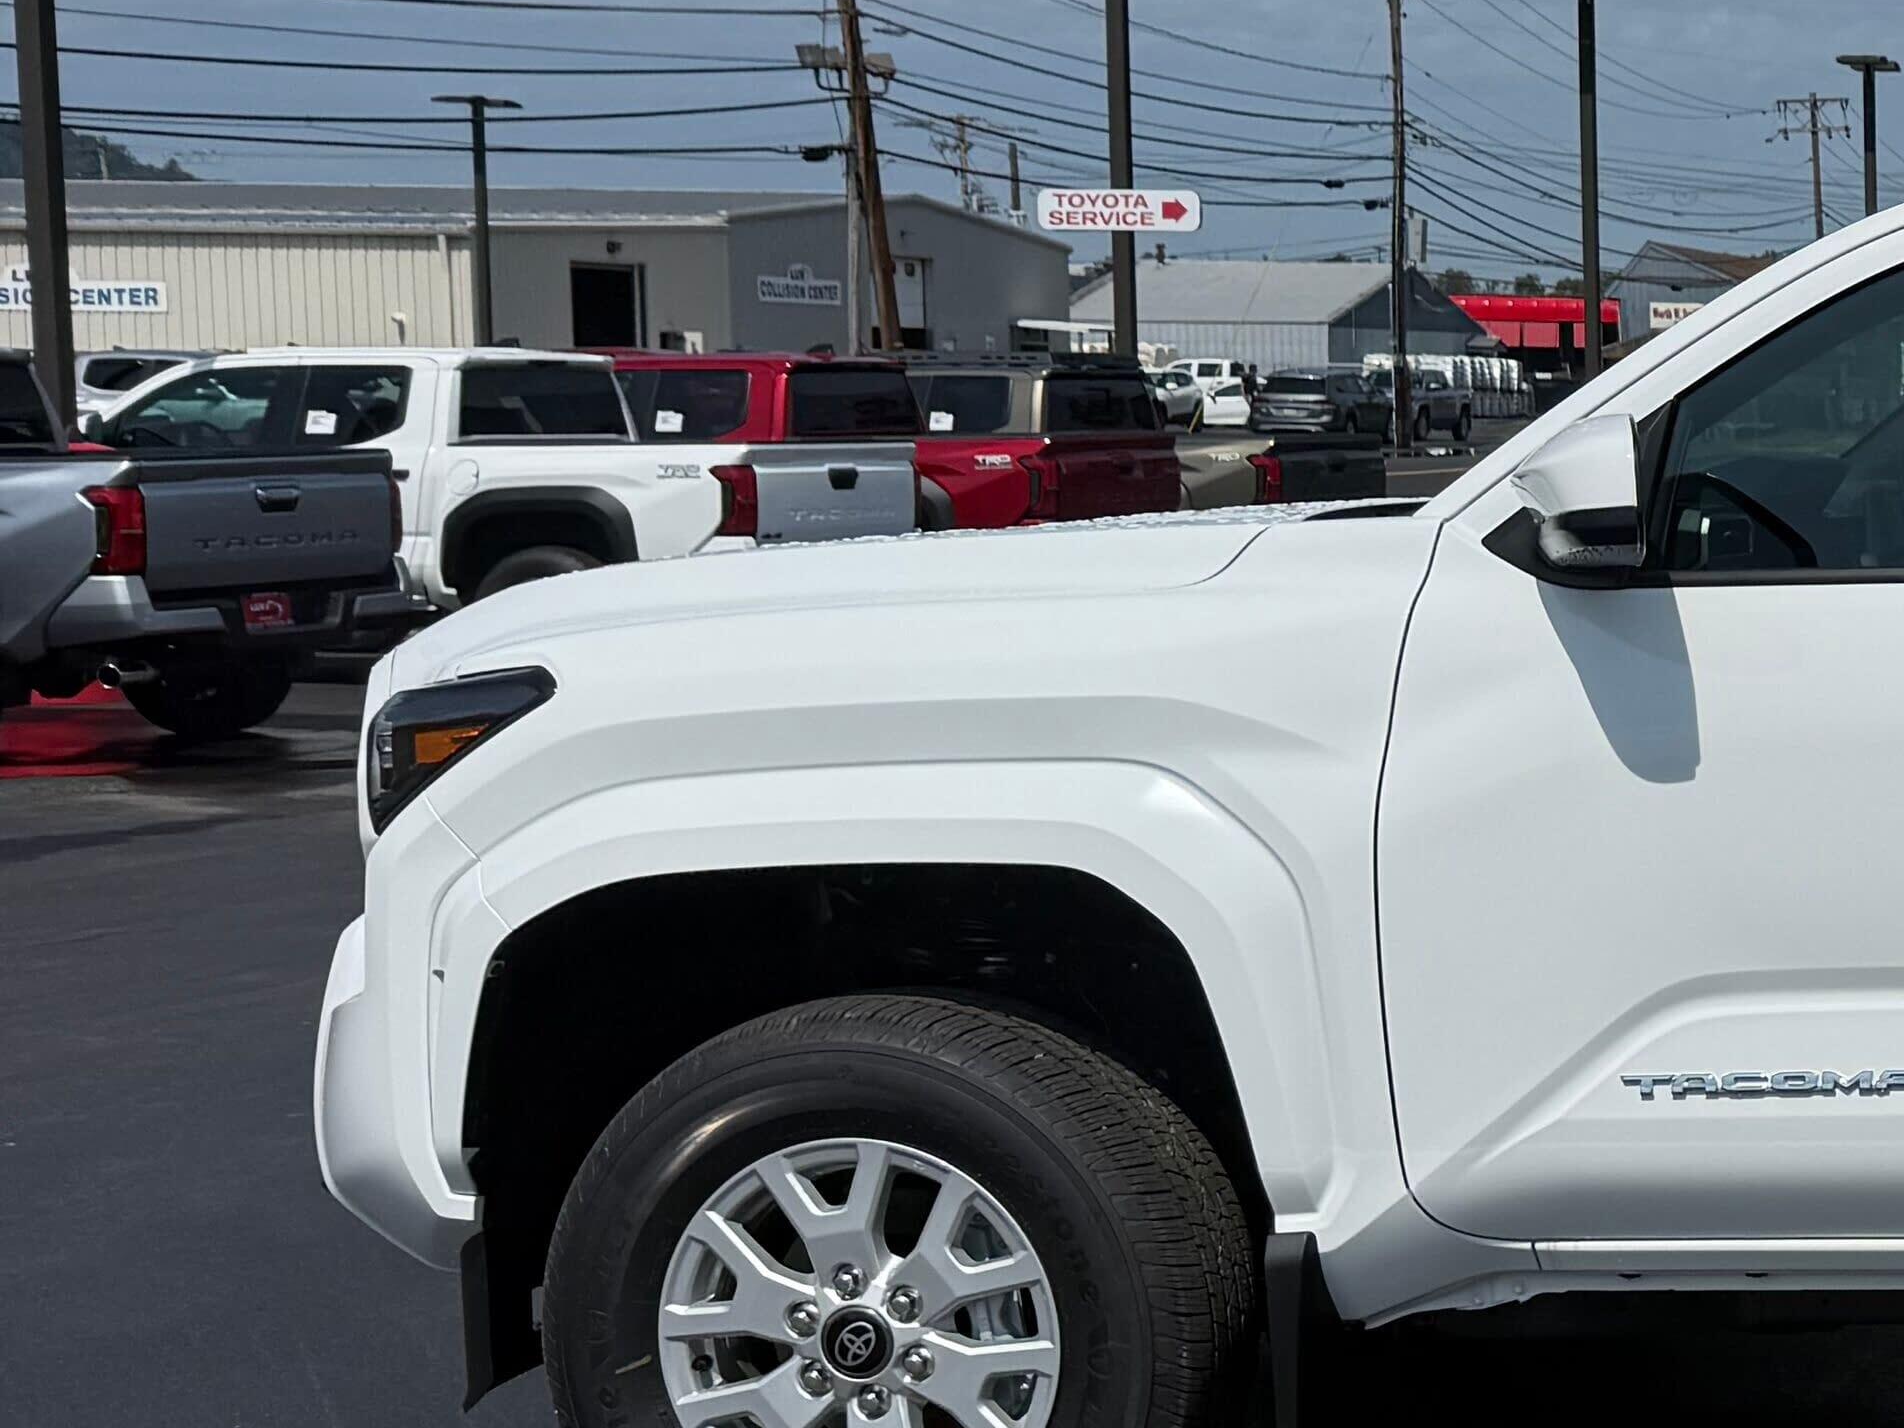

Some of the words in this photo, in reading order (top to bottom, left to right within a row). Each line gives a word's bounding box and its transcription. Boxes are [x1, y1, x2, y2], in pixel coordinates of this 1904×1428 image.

[1053, 193, 1149, 209] TOYOTA
[1048, 210, 1155, 226] SERVICE
[69, 288, 158, 305] CENTER
[974, 454, 1011, 467] TRD
[193, 529, 358, 552] TACOMA
